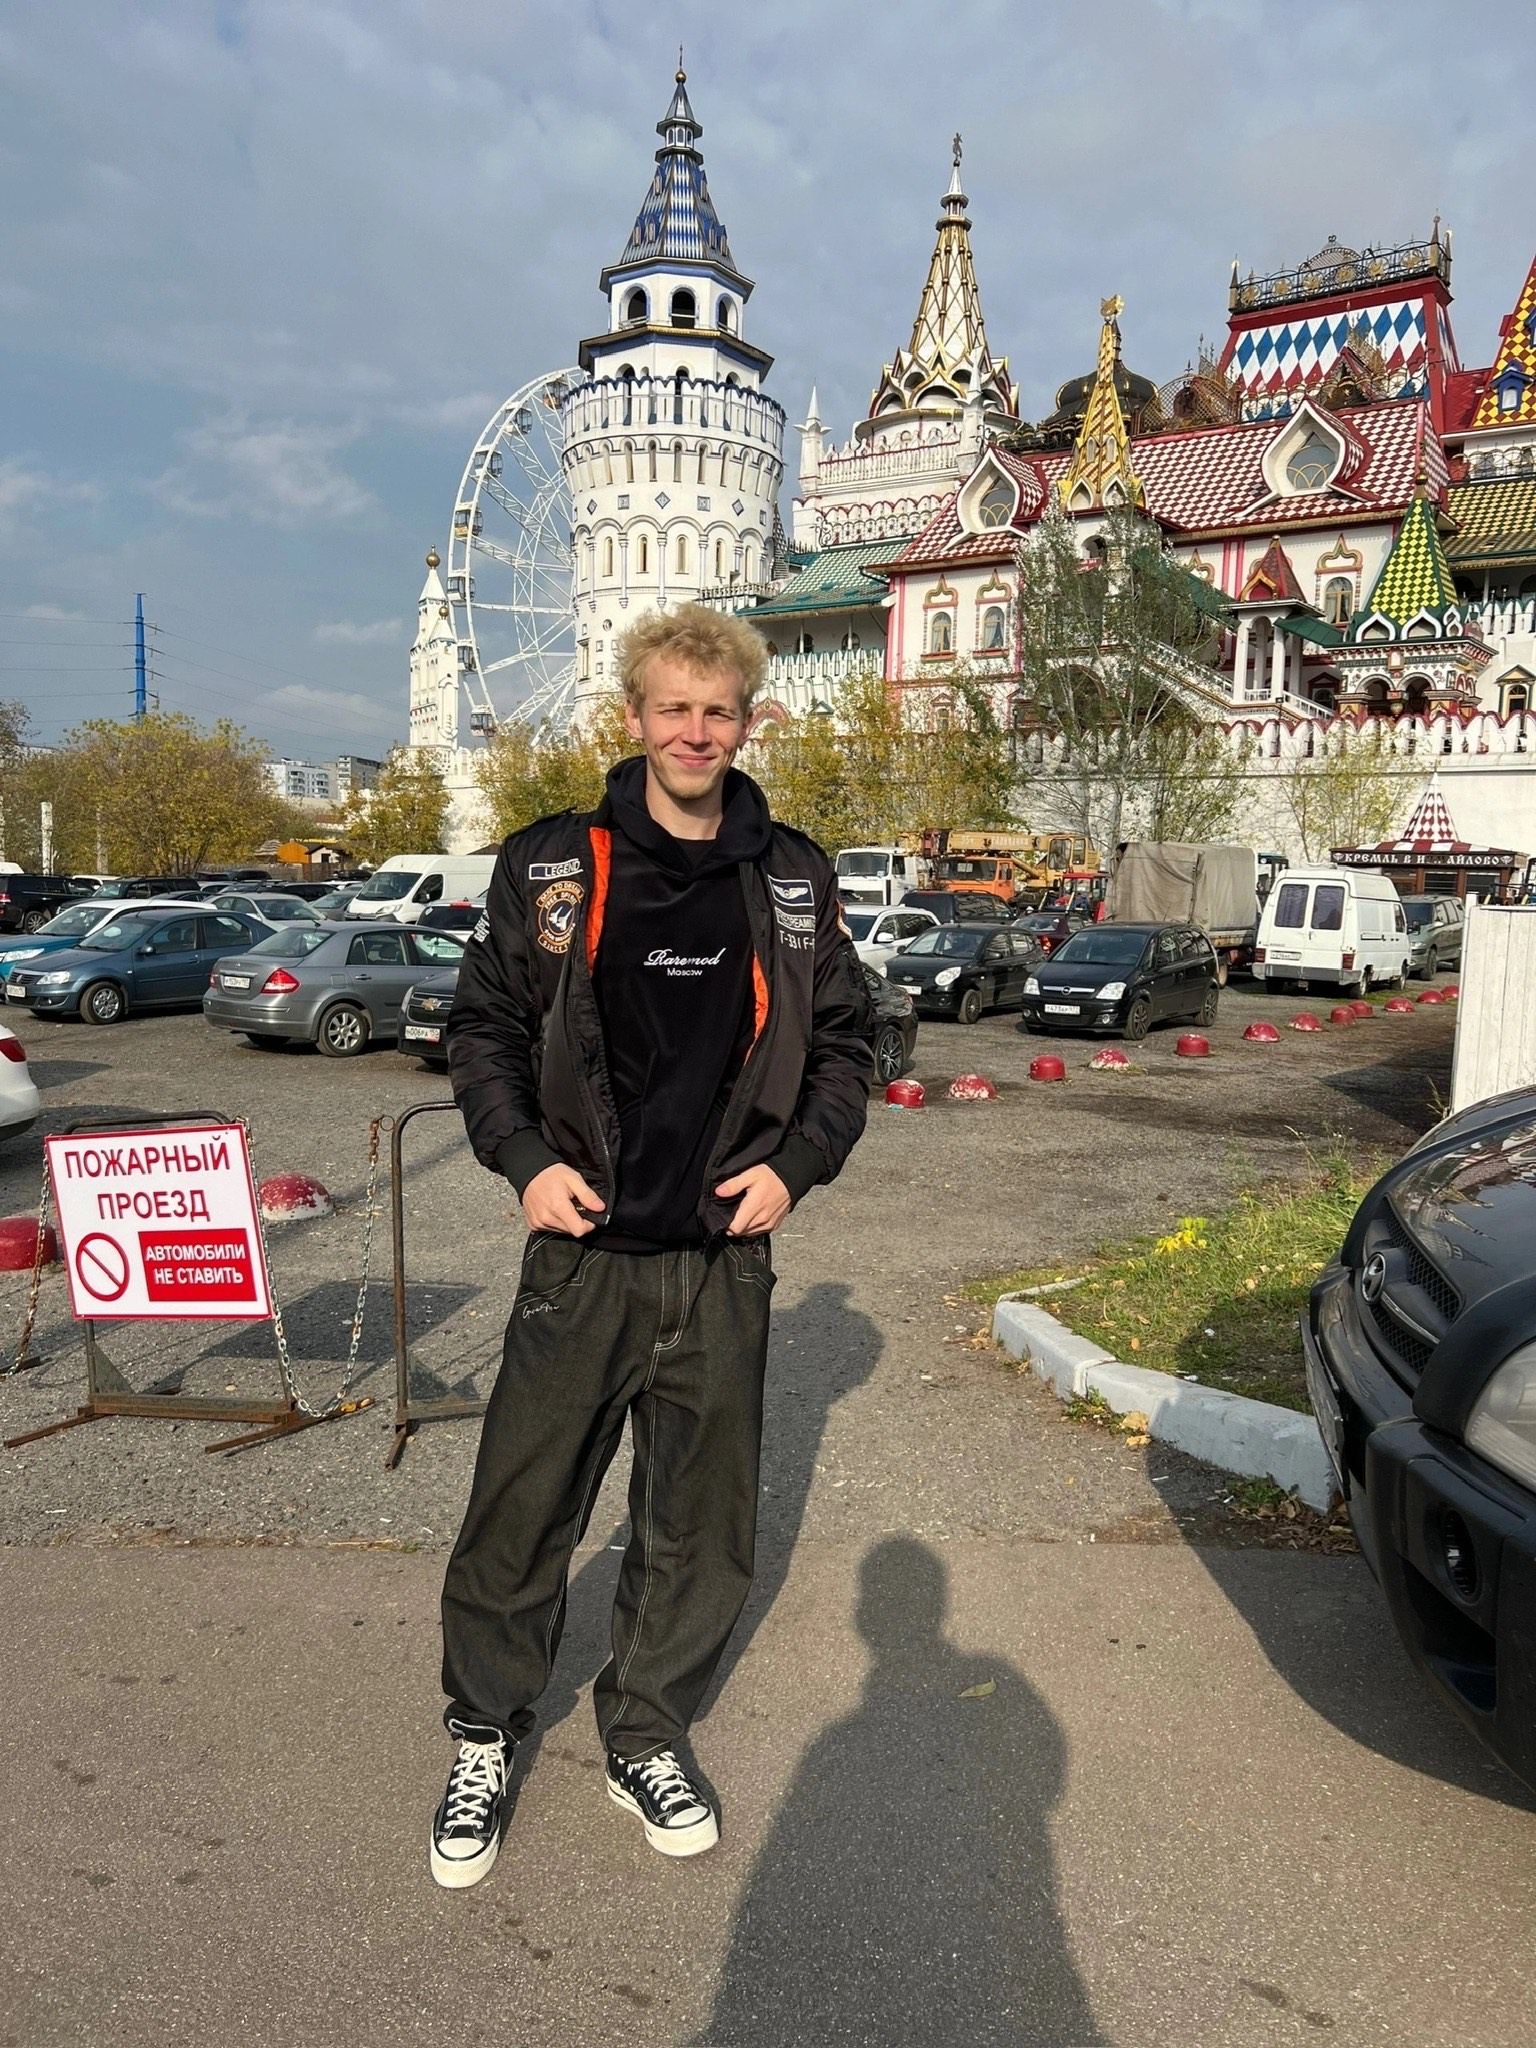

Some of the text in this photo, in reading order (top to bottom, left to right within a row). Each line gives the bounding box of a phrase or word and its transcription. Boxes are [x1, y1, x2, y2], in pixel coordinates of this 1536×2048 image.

[1345, 852, 1500, 865] КРЕМЛЬ В ИАЙЛОВО
[544, 860, 580, 877] LEGEND
[544, 894, 557, 910] FREE
[667, 967, 703, 976] Moscow
[64, 1135, 231, 1178] ПОЖАРНЫЙ
[97, 1189, 211, 1223] ПРОЕЗД
[145, 1243, 246, 1261] АВТОМОБИЛИ
[154, 1267, 244, 1285] НЕ СТАВИТЬ
